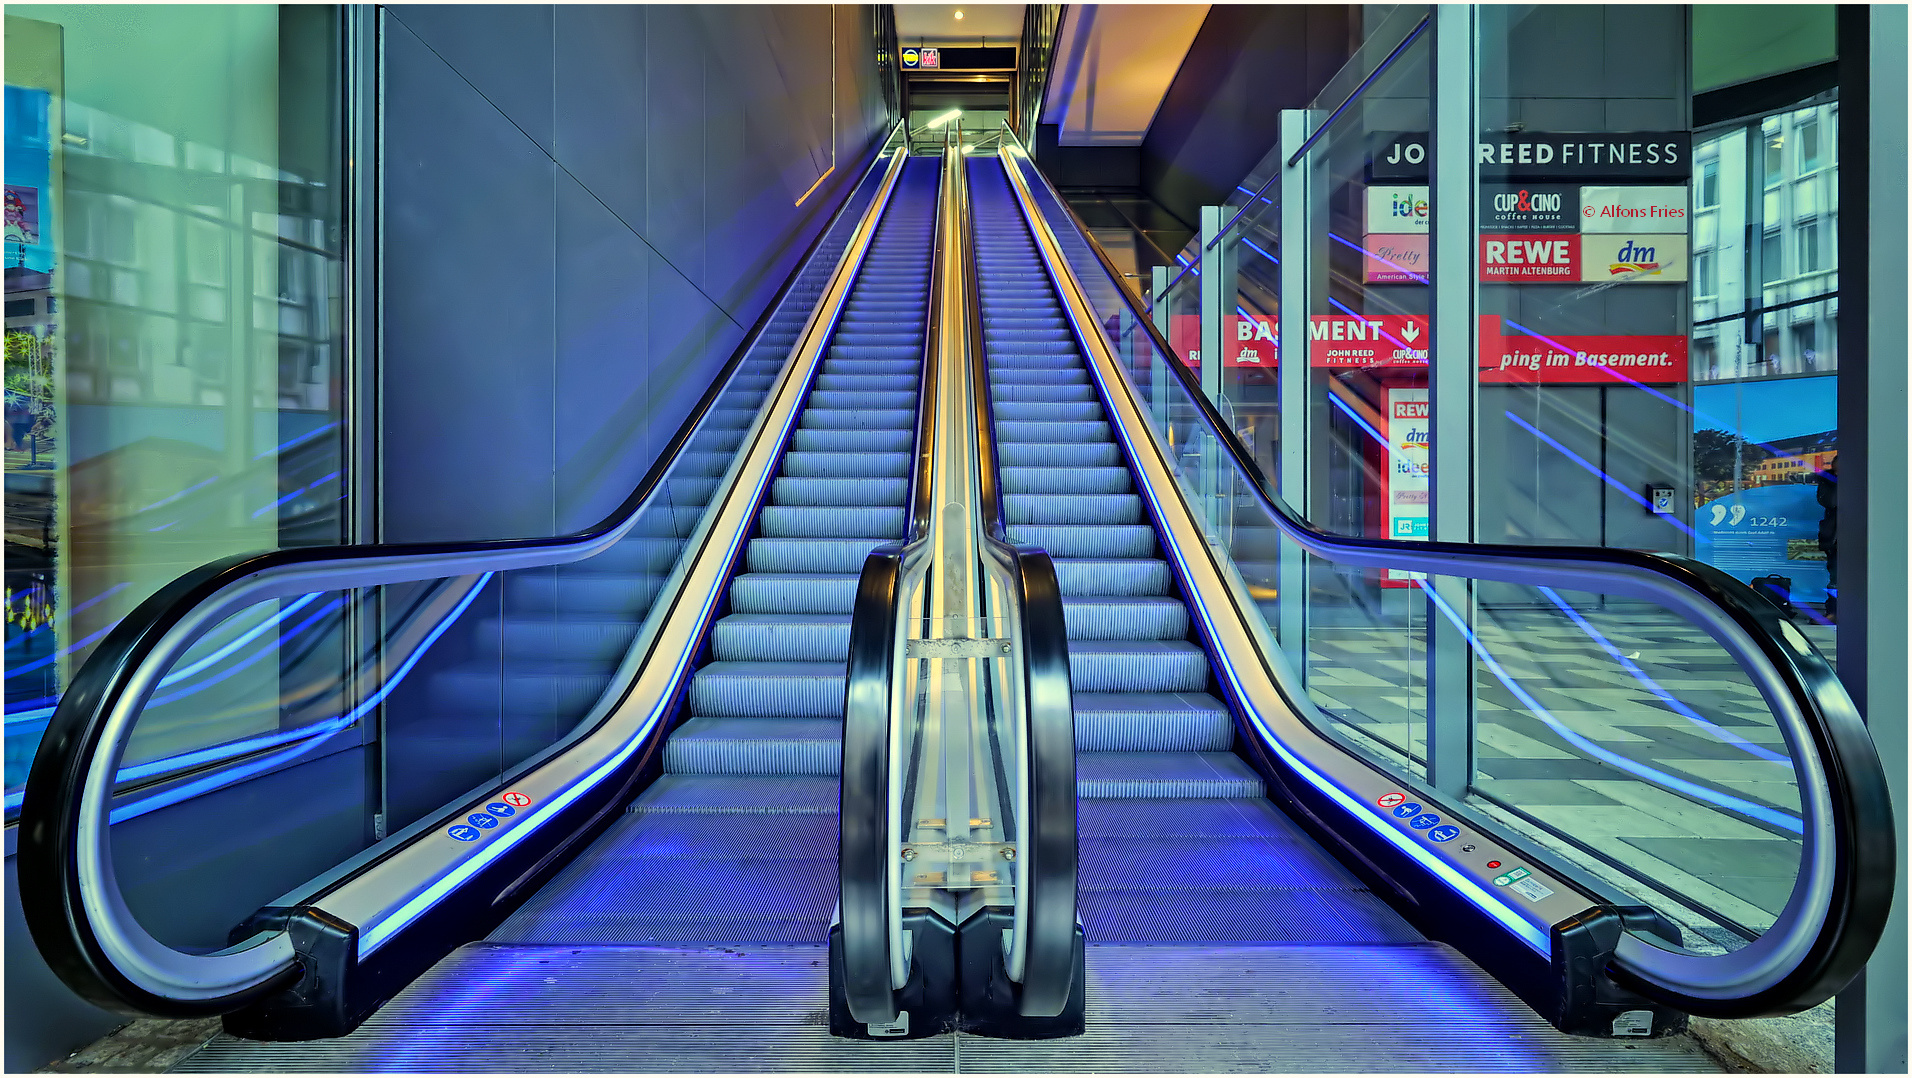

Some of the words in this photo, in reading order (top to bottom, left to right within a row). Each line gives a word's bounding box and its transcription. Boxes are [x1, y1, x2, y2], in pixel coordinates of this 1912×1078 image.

[1387, 143, 1425, 164] JO
[1479, 143, 1553, 164] REED
[1562, 143, 1678, 164] FITNESS
[1393, 193, 1428, 217] ide
[1494, 189, 1561, 212] CUP&CINO
[1495, 212, 1527, 221] coffee
[1375, 246, 1421, 265] Pretty
[1486, 240, 1570, 264] REWE
[1617, 240, 1655, 263] dm
[1486, 266, 1520, 275] MARTIN
[1521, 266, 1571, 275] ALTENBURG
[1240, 346, 1258, 358] dm
[1327, 349, 1351, 357] JOHN
[1352, 349, 1374, 357] REED
[1393, 347, 1428, 360] CUP&CINO
[1500, 351, 1542, 371] ping
[1546, 351, 1569, 367] im
[1574, 351, 1673, 367] Basement.
[1396, 404, 1429, 417] REW
[1750, 517, 1788, 527] 1242
